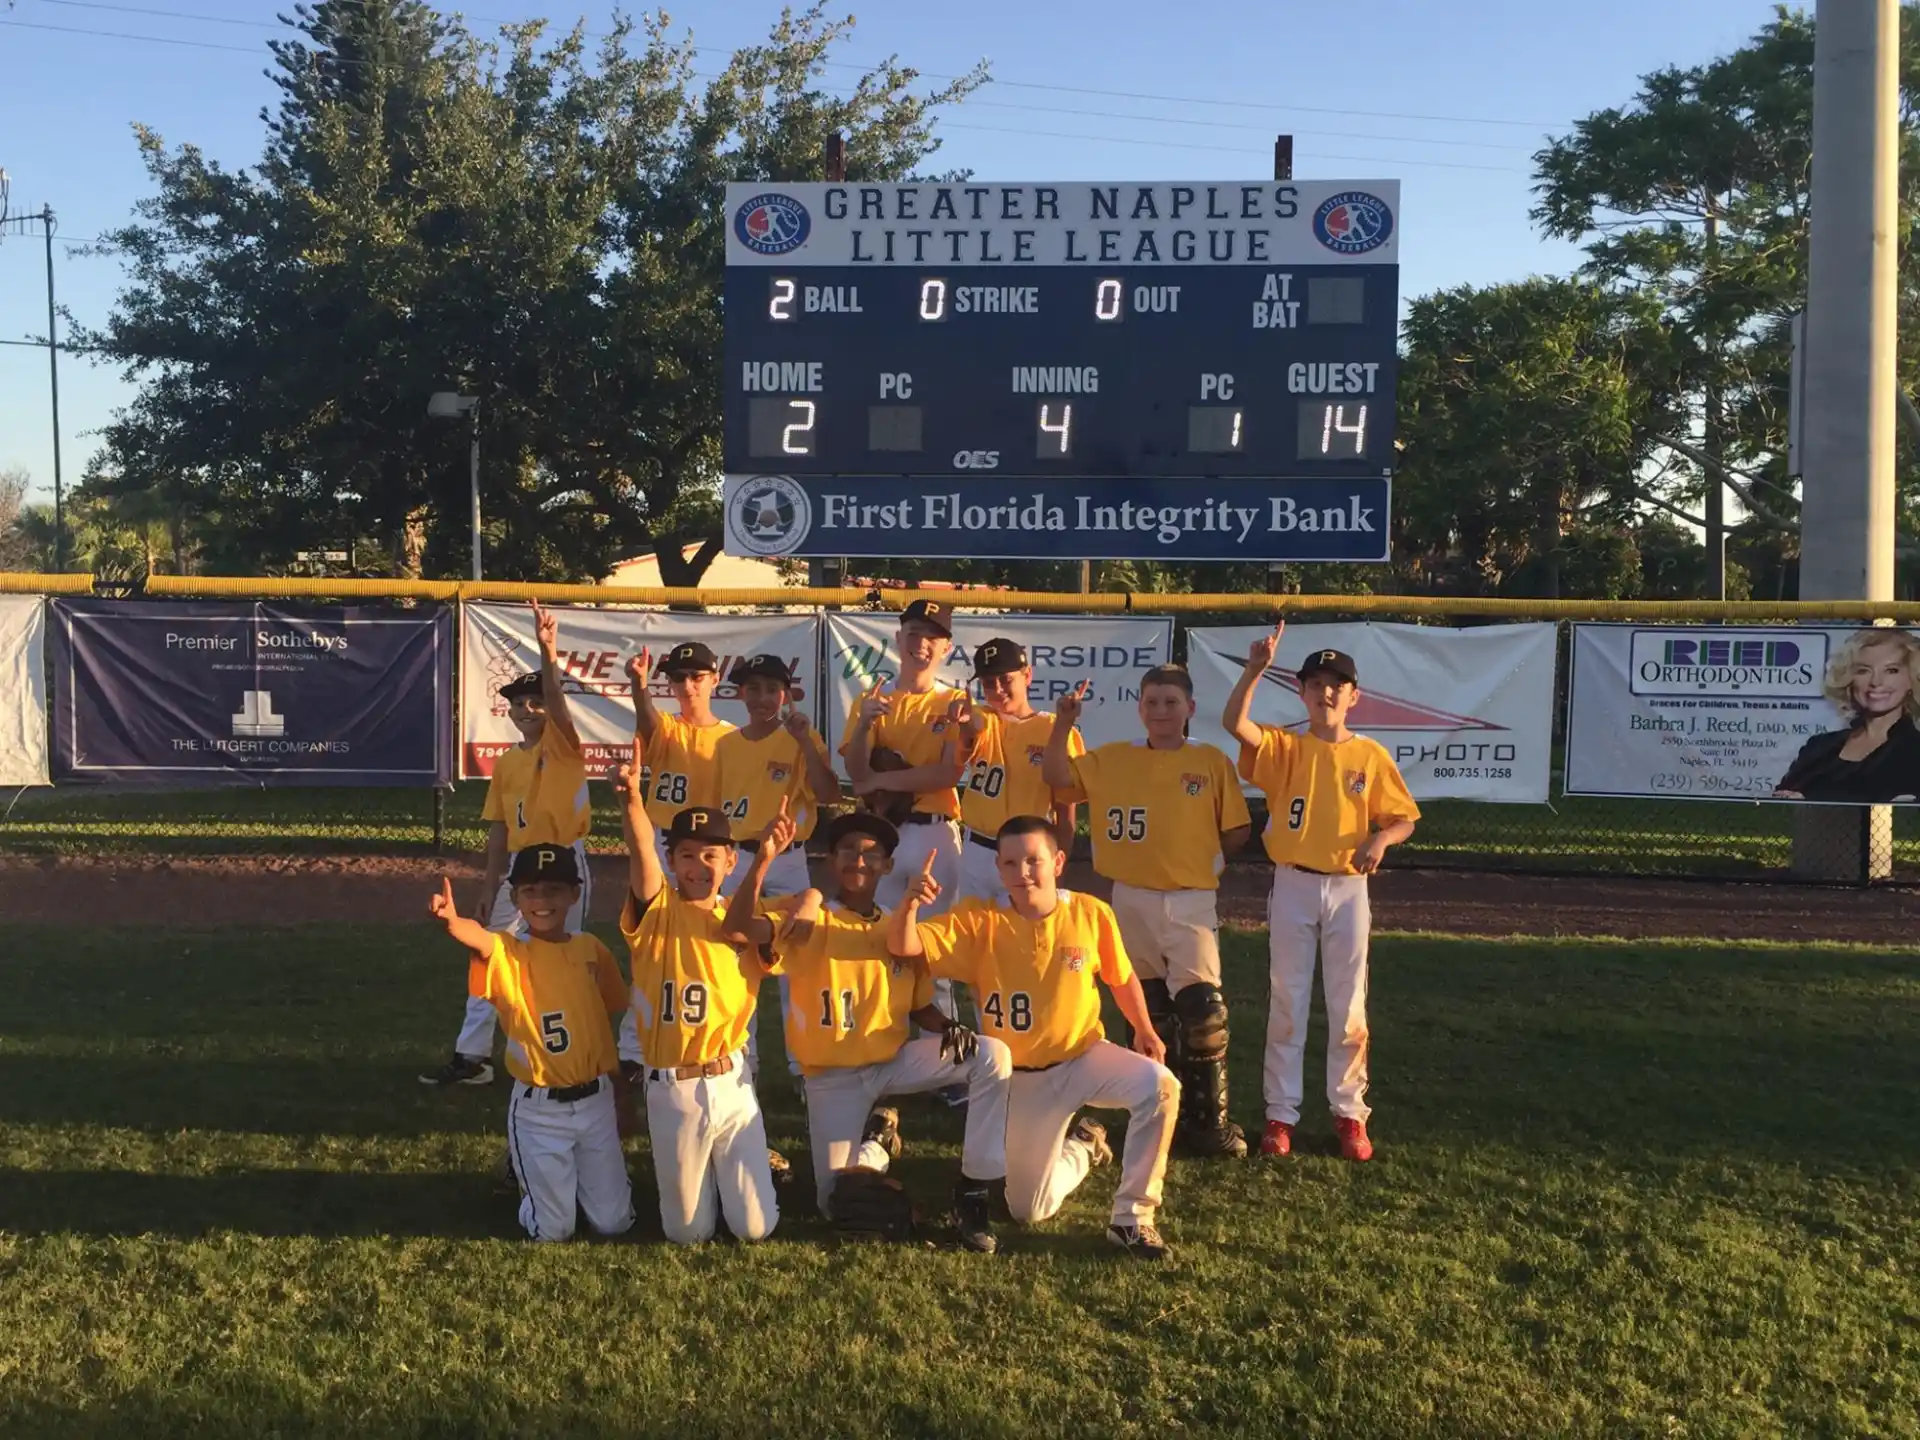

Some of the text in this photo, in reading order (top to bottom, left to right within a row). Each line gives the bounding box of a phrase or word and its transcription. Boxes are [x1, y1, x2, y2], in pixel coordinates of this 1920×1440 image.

[824, 186, 1298, 220] GREATER NAPLES
[851, 230, 1270, 262] LITTLE LEAGUE
[769, 279, 1181, 320] 2 BALL 0 STRIKE 0 OUT
[1261, 273, 1293, 300] AT
[1252, 301, 1300, 328] BAT
[742, 361, 823, 392] HOME
[880, 373, 912, 400] PC
[1012, 366, 1099, 393] INNING
[1200, 373, 1234, 400] PC
[1287, 362, 1379, 393] GUEST
[782, 400, 815, 453] 2
[1040, 404, 1071, 453] 4
[1231, 412, 1241, 447] 1
[1321, 404, 1367, 454] 14
[953, 450, 1000, 469] OES
[821, 493, 1375, 544] First Florida Integrity Bank
[924, 603, 939, 617] P
[165, 631, 348, 652] Premier Sotheby's
[984, 646, 998, 665] P
[1664, 640, 1800, 667] REED
[1319, 651, 1336, 665] P
[1640, 660, 1812, 685] ORTHODONTICS
[1687, 716, 1701, 735] J.
[1707, 716, 1752, 735] Reed,
[1756, 722, 1788, 735] DMD,
[172, 739, 350, 753] THE LUTGERT COMPANIES
[1396, 745, 1515, 762] PHOTO
[970, 759, 1005, 799] 20
[1434, 768, 1512, 778] 800.735.1258
[1650, 772, 1773, 792] (239) 596-2255
[655, 771, 690, 805] 28
[516, 799, 528, 830] 1
[691, 812, 709, 832] P
[1107, 806, 1147, 842] 35
[1288, 796, 1305, 831] 9
[538, 850, 555, 870] P
[662, 980, 708, 1027] 19
[820, 988, 856, 1032] 11
[983, 990, 1034, 1033] 48
[541, 1010, 571, 1055] 5
